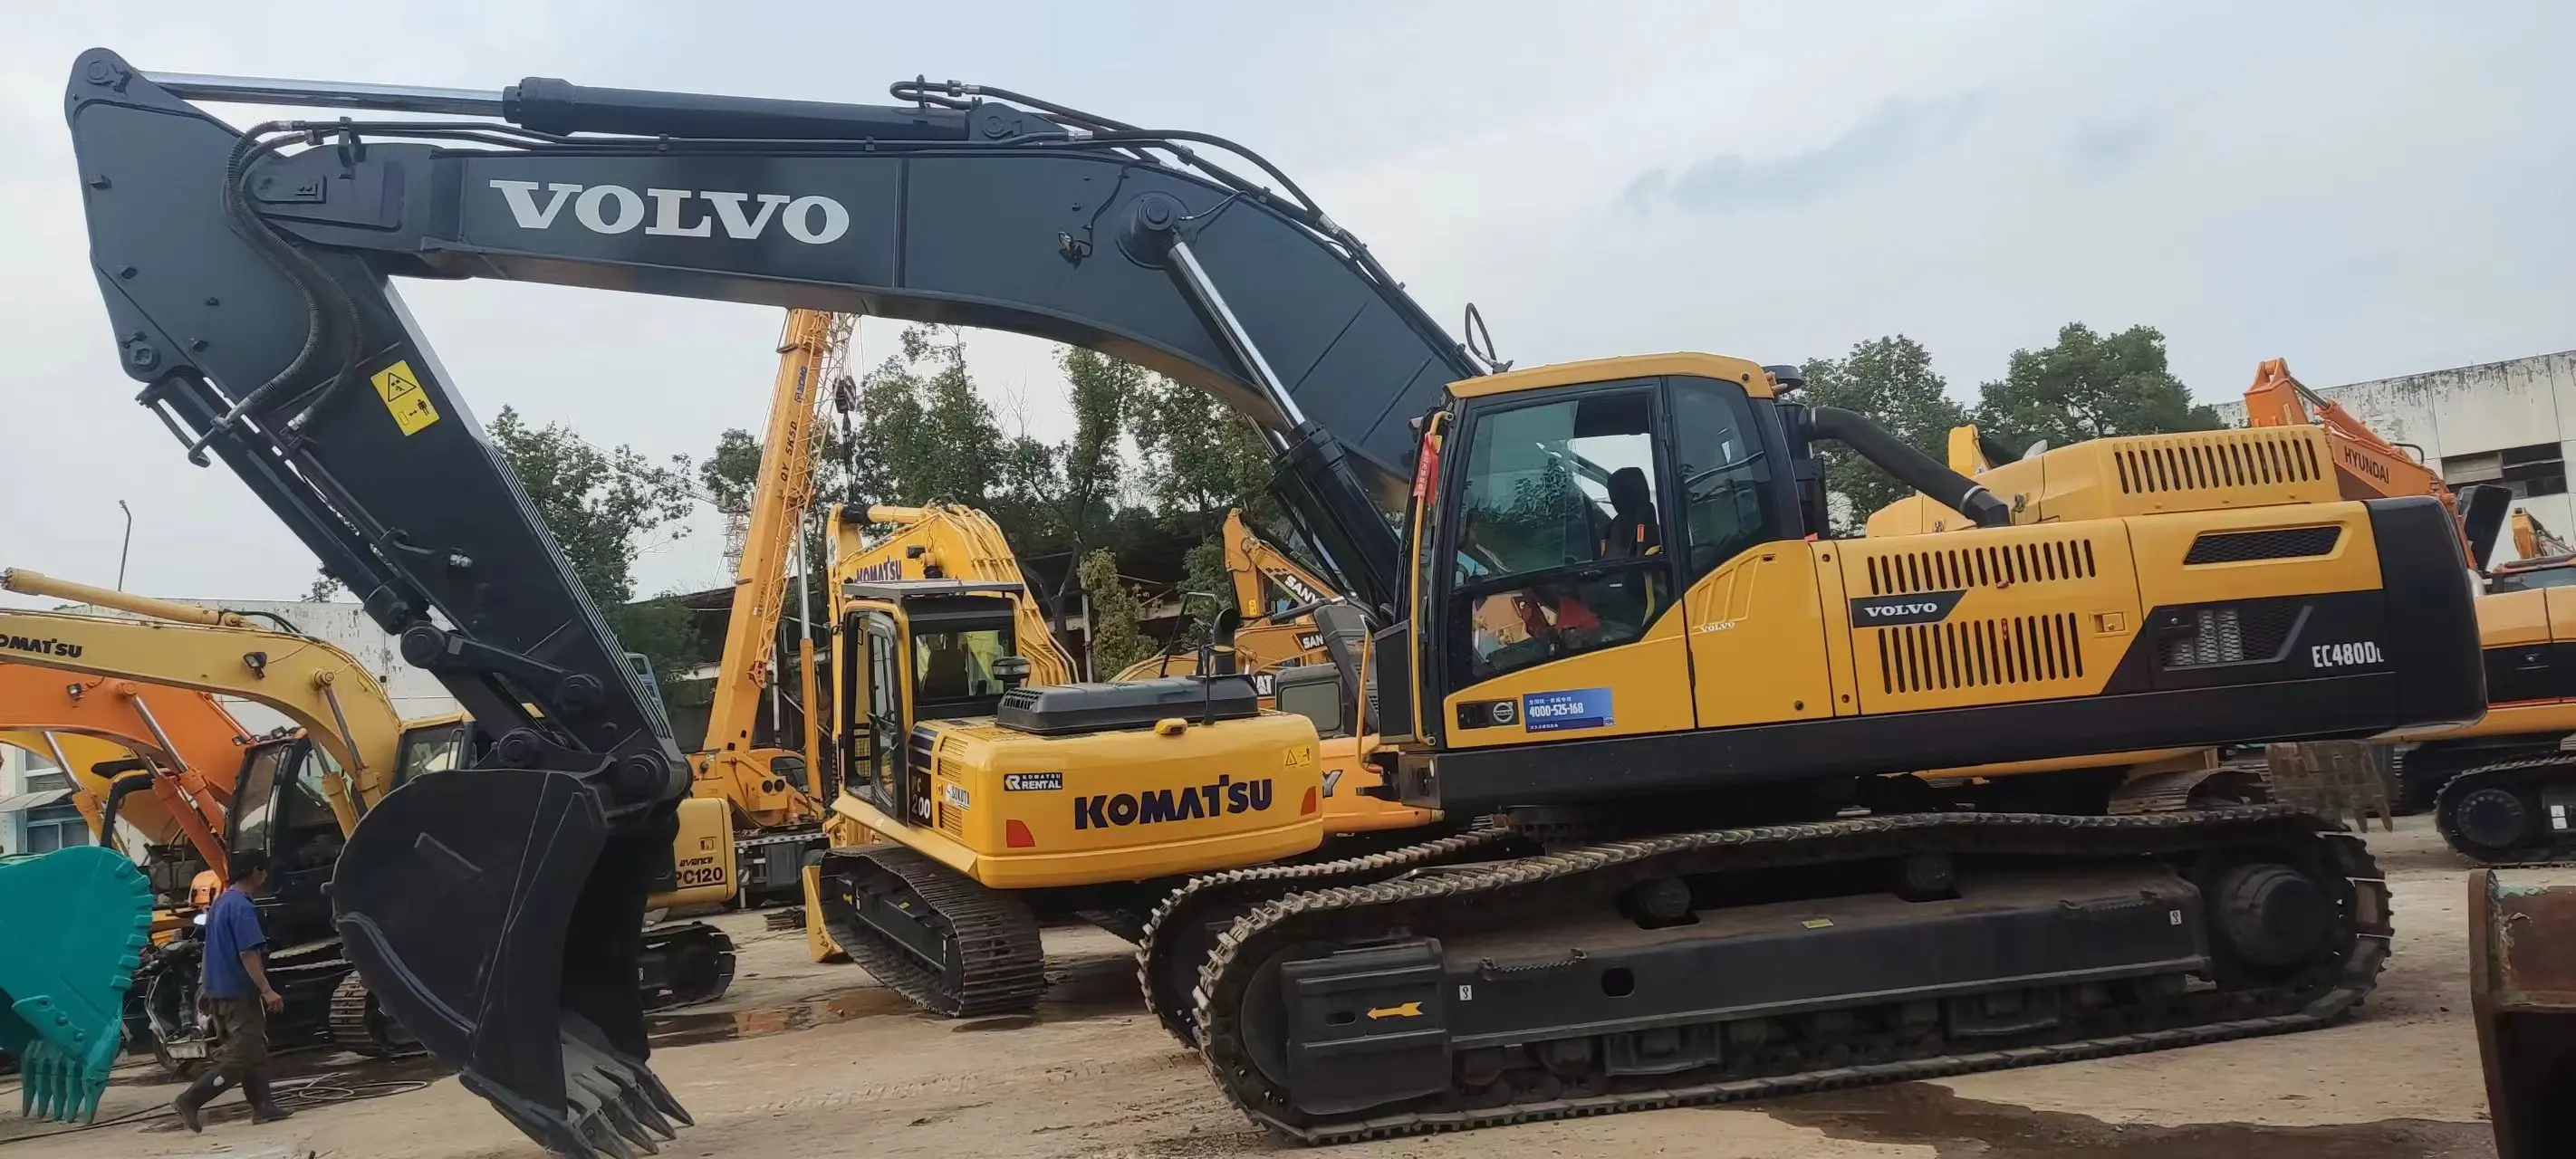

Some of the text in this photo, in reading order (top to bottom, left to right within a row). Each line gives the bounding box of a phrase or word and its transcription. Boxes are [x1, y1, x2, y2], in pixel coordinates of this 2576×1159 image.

[490, 179, 850, 244] VOLVO
[2344, 445, 2389, 484] HYUNDAI
[856, 555, 902, 582] KOMATSU
[1864, 602, 1937, 618] VOLVO
[1699, 622, 1735, 633] VOLVO
[0, 634, 83, 658] OMATSU
[1302, 634, 1324, 649] SAN
[2312, 641, 2385, 668] EC480DL
[1253, 675, 1273, 694] AT
[1529, 703, 1584, 717] 4000-525-168
[1021, 780, 1062, 790] RENTAL
[911, 793, 931, 819] 200
[1074, 774, 1273, 830] KOMATSU
